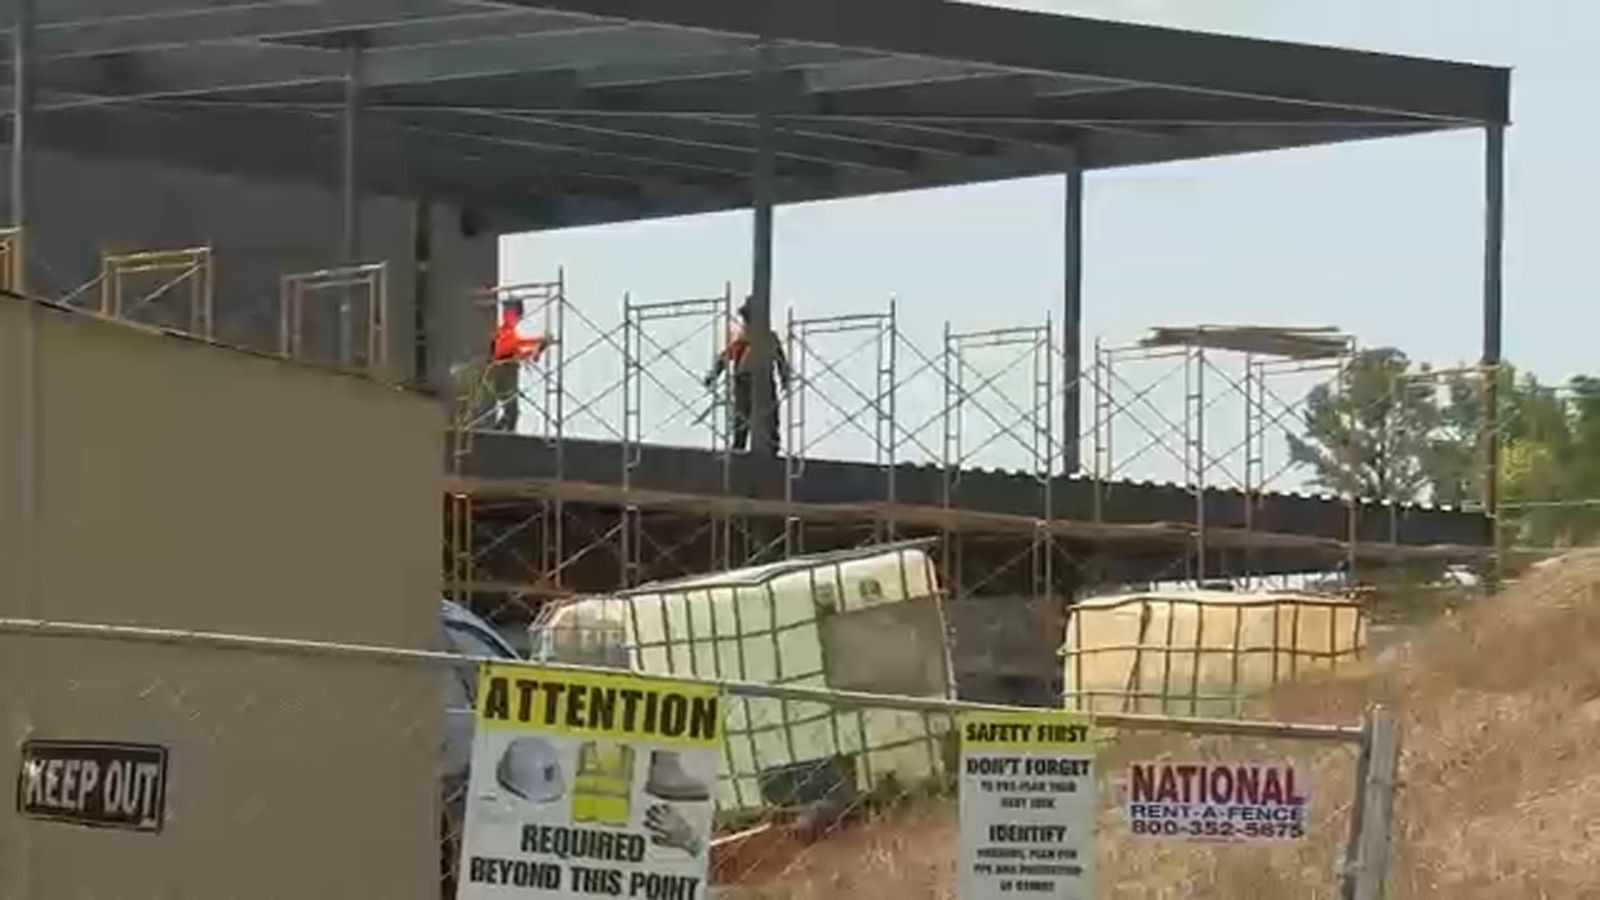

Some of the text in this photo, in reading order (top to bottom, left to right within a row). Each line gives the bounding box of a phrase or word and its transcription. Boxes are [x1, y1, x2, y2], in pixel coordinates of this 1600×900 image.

[483, 677, 718, 740] ATTENTION
[966, 723, 1088, 743] SAFETY FIRST
[966, 757, 1091, 776] DON'T FORGET
[1132, 764, 1306, 805] NATIONAL
[23, 759, 158, 815] KEEP OUT
[1130, 804, 1305, 822] RENT-A-FENCE
[520, 824, 646, 863] REQUIRED
[989, 824, 1067, 842] IDENTIFY
[470, 856, 700, 900] BEYOND THIS POINT
